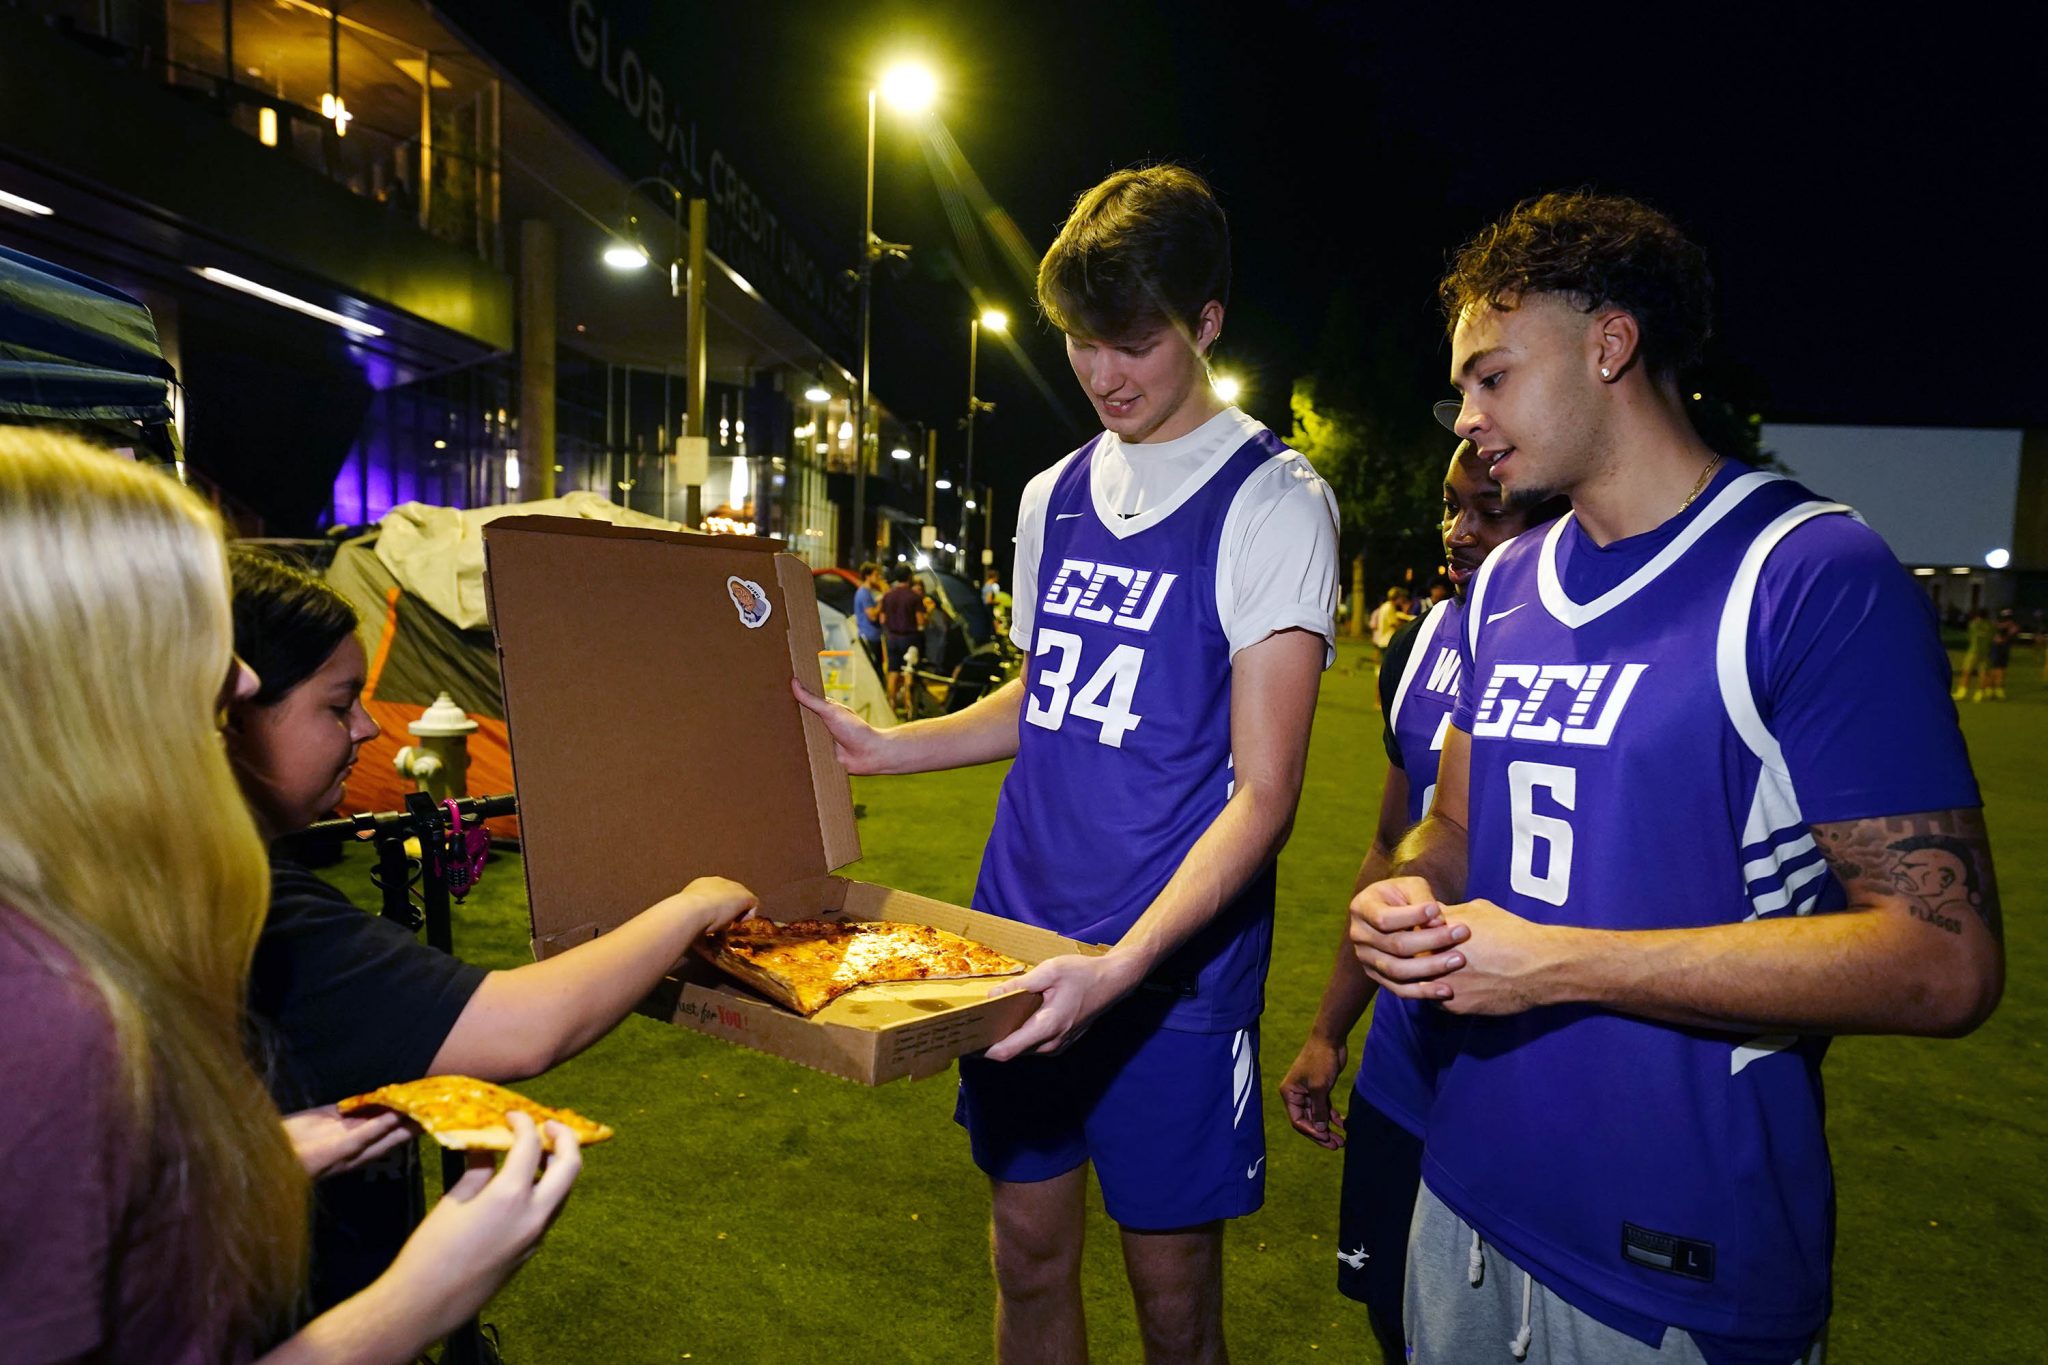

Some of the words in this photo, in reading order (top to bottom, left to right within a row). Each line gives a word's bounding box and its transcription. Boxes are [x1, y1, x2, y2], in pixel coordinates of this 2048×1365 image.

[569, 0, 704, 185] GLOBAL
[1043, 558, 1179, 632] GCU
[1025, 627, 1145, 748] 34
[1472, 663, 1650, 746] GCU
[1507, 760, 1577, 907] 6
[700, 1002, 717, 1025] for
[1687, 1250, 1698, 1267] L
